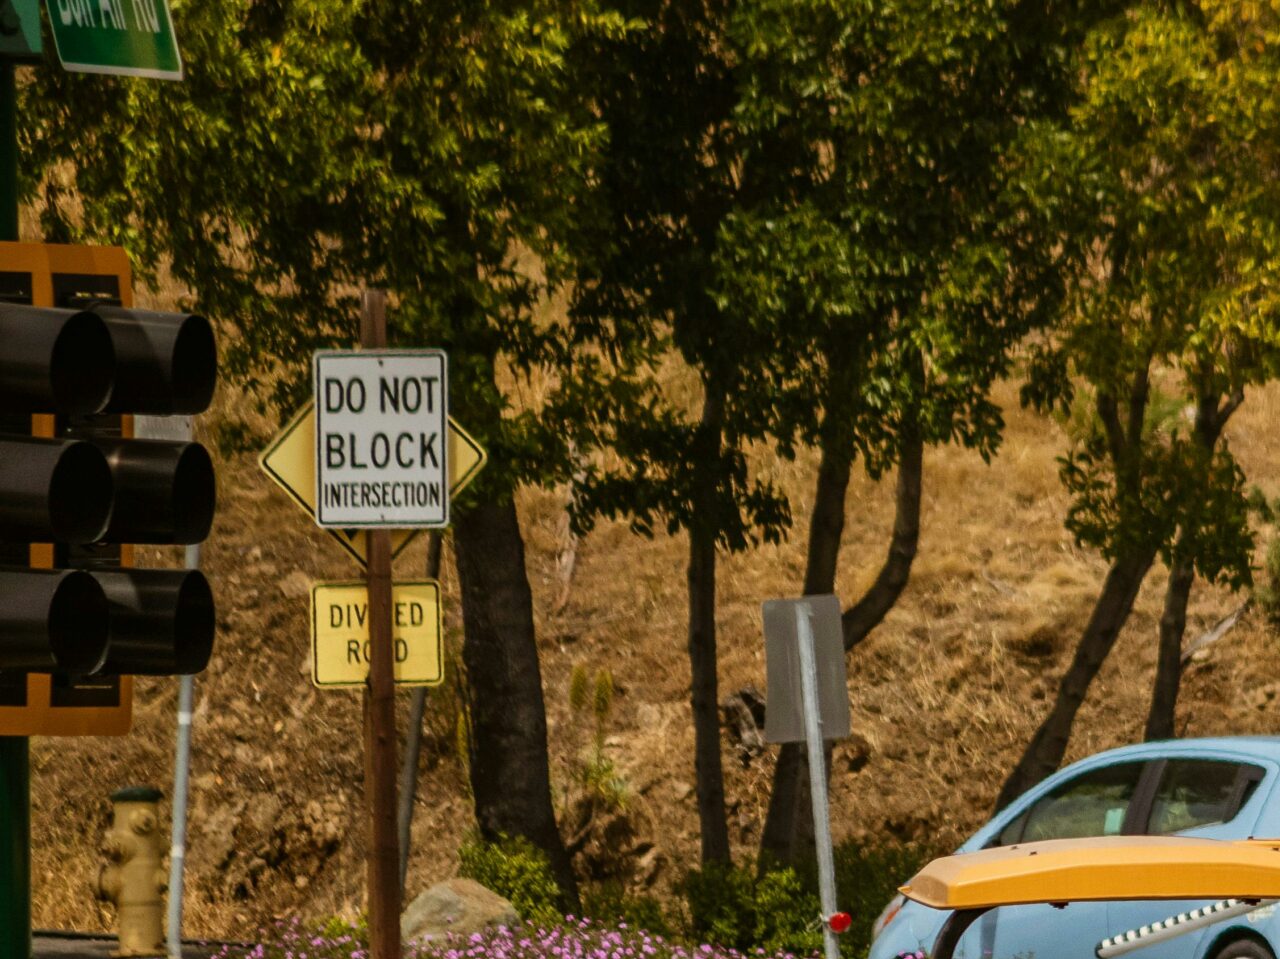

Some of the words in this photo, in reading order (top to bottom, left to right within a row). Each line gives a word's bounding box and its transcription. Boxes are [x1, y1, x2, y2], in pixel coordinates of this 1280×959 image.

[325, 377, 366, 414] DO
[380, 377, 438, 414] NOT
[326, 432, 439, 469] BLOCK
[324, 482, 440, 508] INTERSECTION
[330, 602, 424, 628] DIVED
